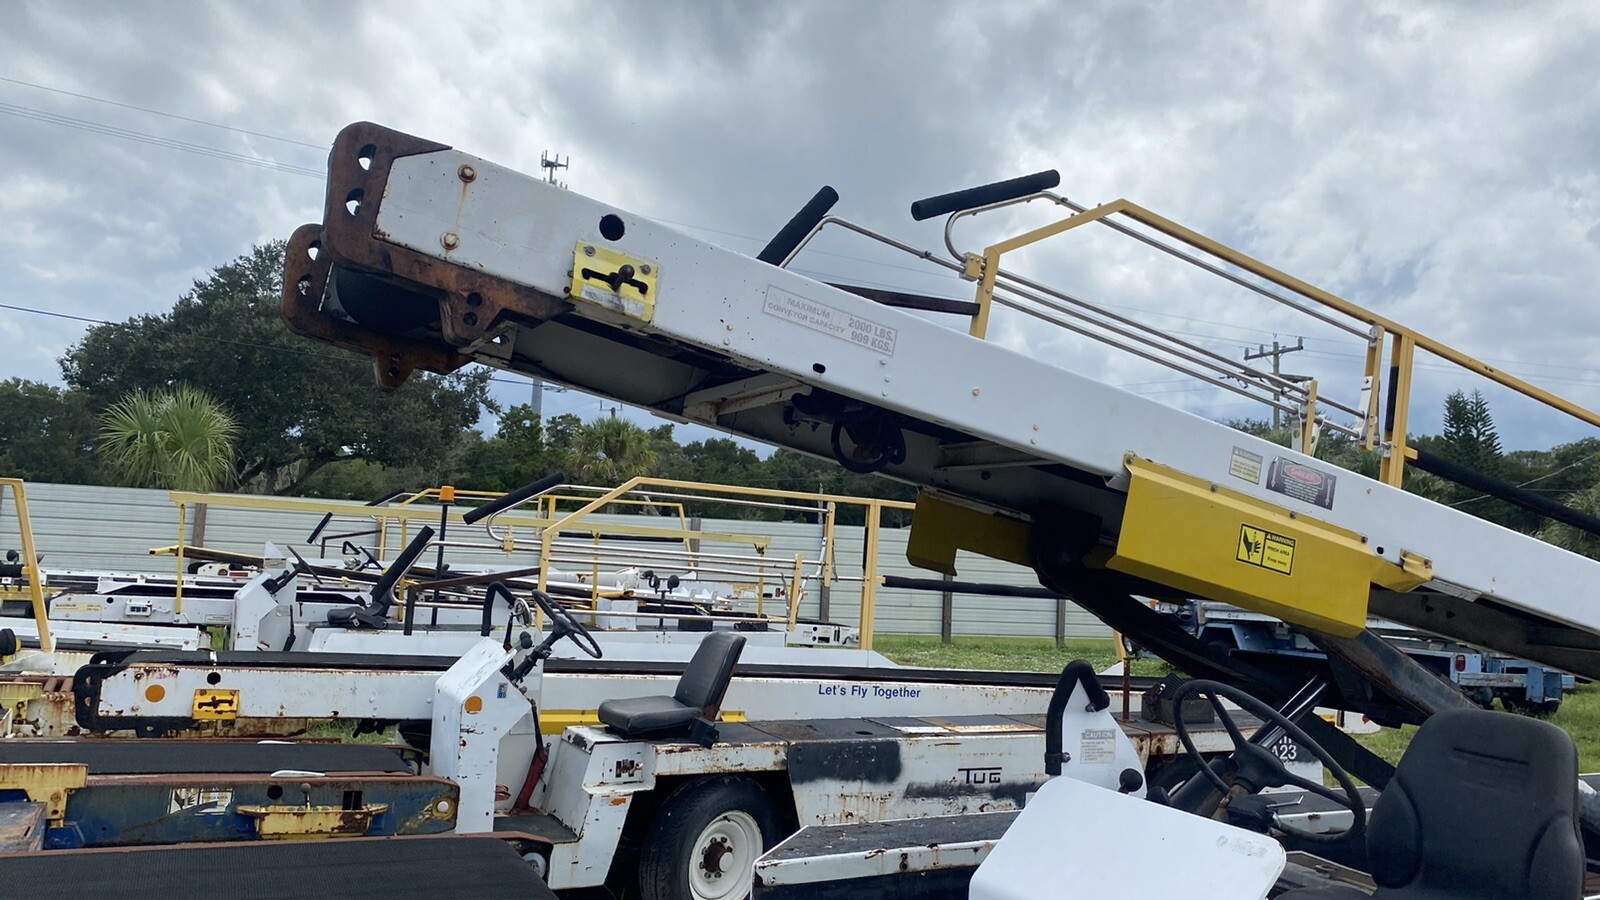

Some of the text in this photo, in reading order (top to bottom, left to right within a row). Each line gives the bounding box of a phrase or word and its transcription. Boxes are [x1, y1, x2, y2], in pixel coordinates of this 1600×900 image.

[767, 302, 845, 334] CONVEYOR CAPACITY
[787, 298, 830, 319] MAXIMUM
[848, 317, 894, 341] 2000 LBS.
[850, 331, 892, 353] 909 KGS.
[1291, 467, 1315, 479] DANGER
[1271, 535, 1295, 547] WARNING
[818, 684, 921, 700] Let's Fly Together
[1084, 731, 1113, 740] CAUTION
[957, 766, 1003, 785] TUG
